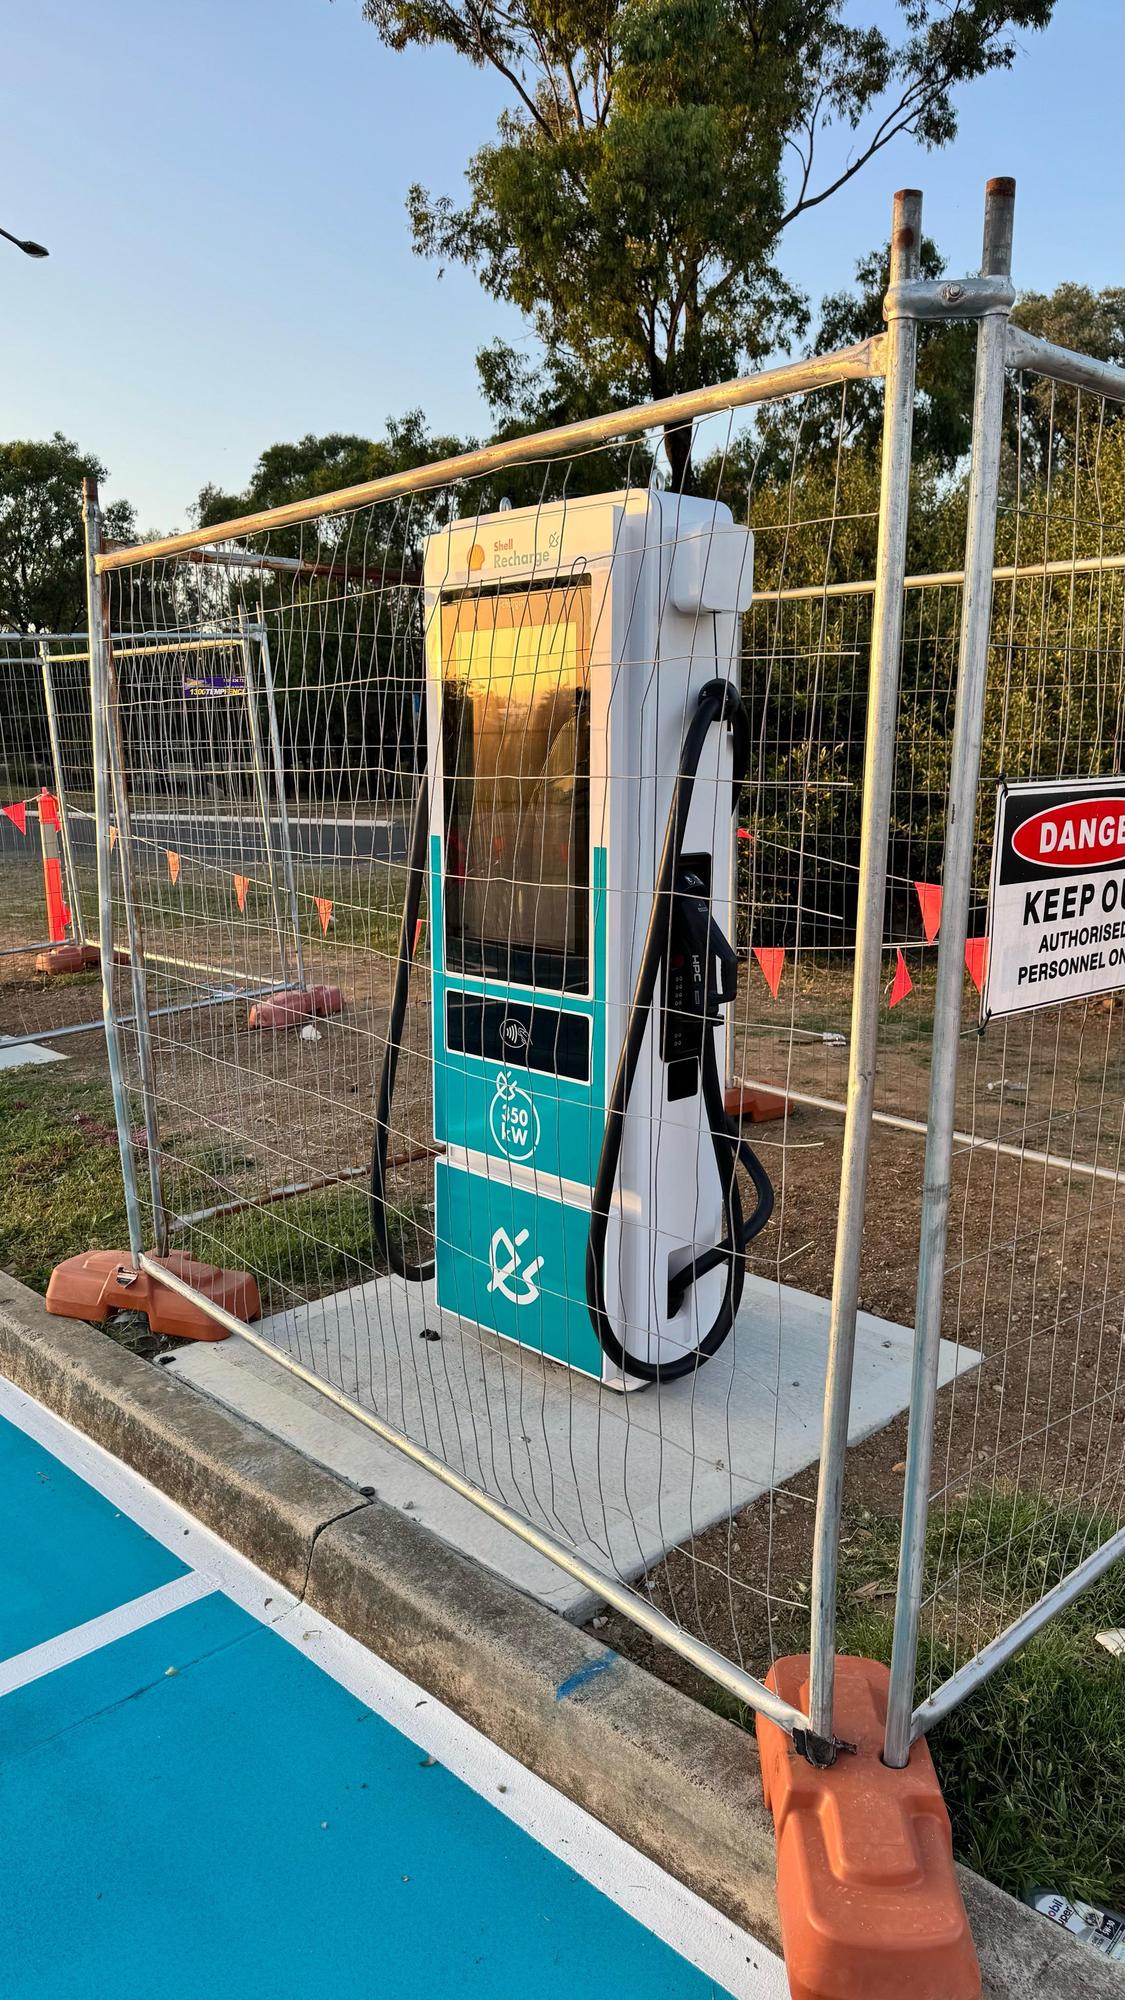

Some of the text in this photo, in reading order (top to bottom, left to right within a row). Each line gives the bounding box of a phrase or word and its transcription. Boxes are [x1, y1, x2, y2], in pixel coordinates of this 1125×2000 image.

[493, 538, 514, 552] Shell
[493, 550, 550, 569] Recharge
[1023, 878, 1125, 926] KEEP O
[691, 954, 702, 982] HPC
[1017, 951, 1106, 986] PERSONNEL
[501, 1103, 529, 1127] 350
[501, 1121, 529, 1146] kW
